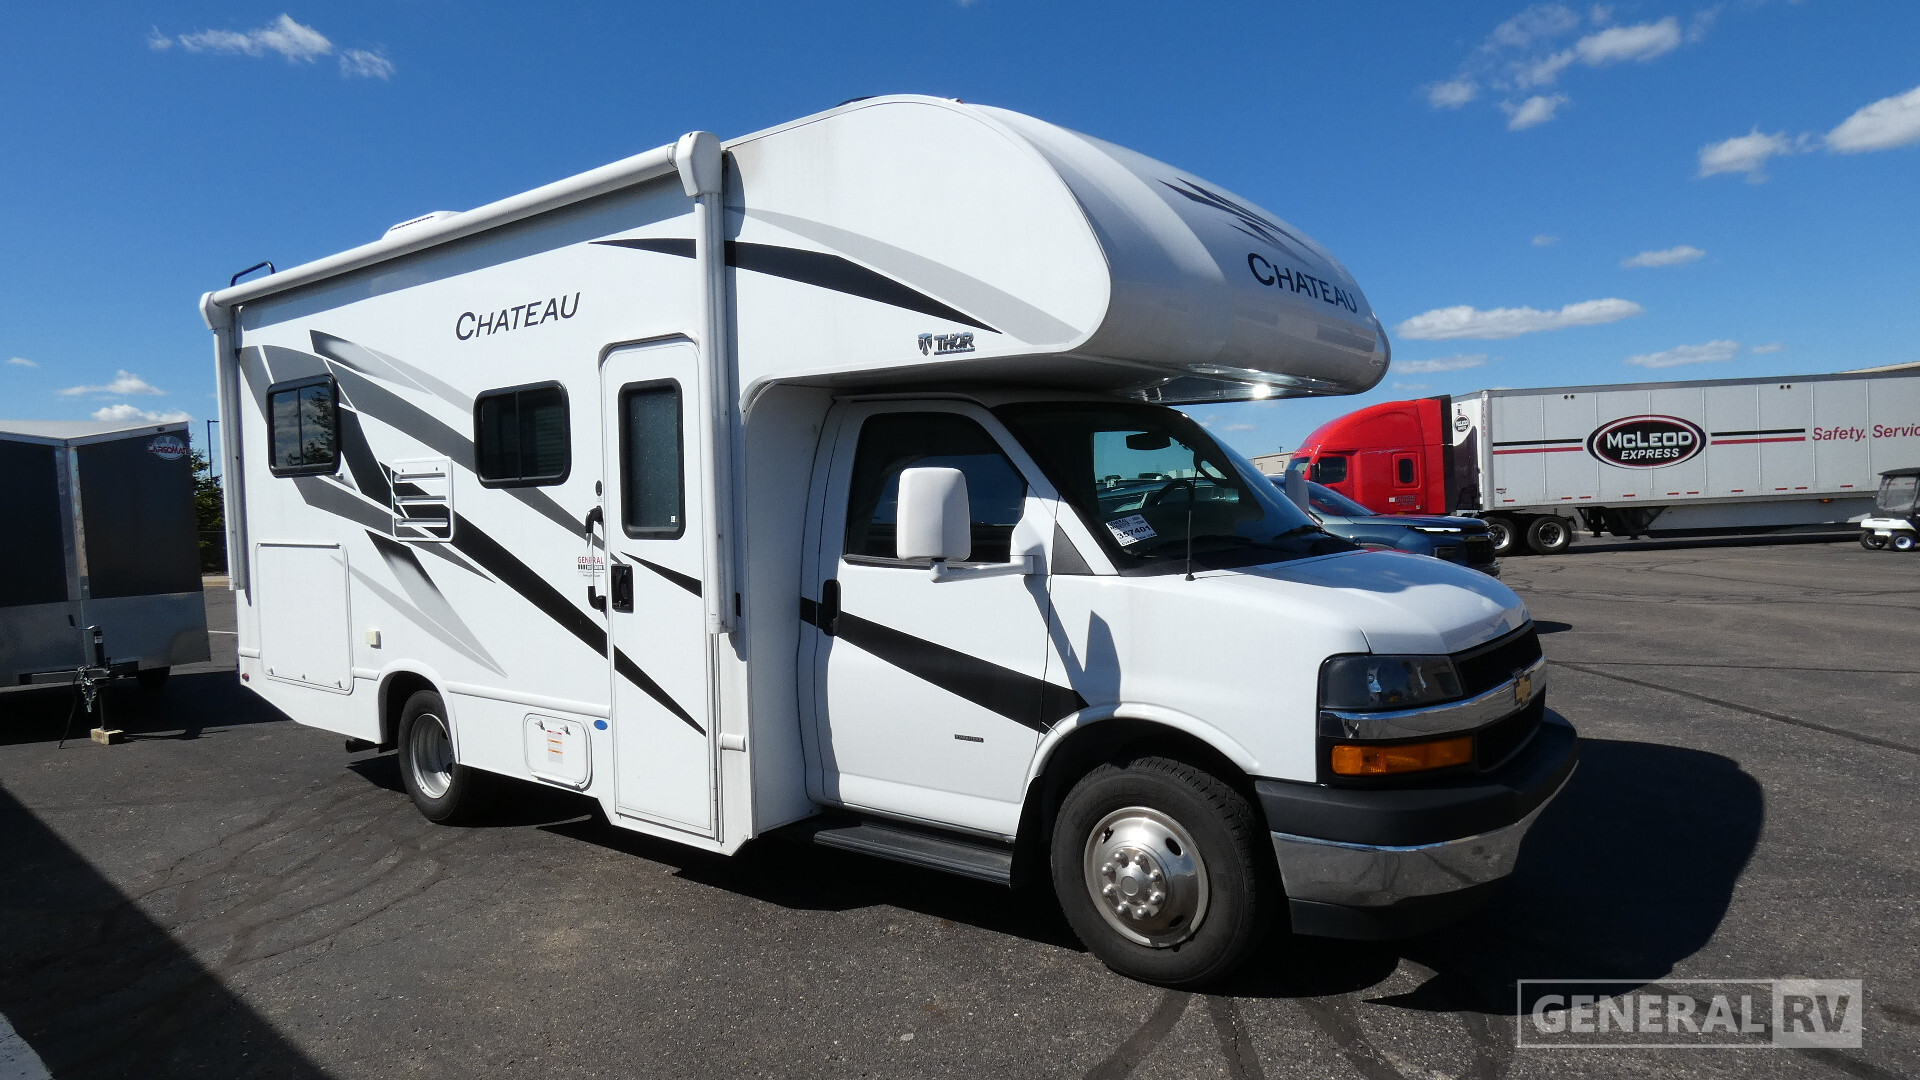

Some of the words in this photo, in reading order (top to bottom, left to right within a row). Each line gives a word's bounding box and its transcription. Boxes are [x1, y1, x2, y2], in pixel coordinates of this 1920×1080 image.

[1247, 252, 1358, 314] CHATEAU
[455, 291, 581, 341] CHATEAU
[934, 332, 975, 351] THOR
[1812, 426, 1866, 442] Safety.
[1620, 448, 1680, 460] EXPRESS
[1116, 525, 1152, 540] 357401
